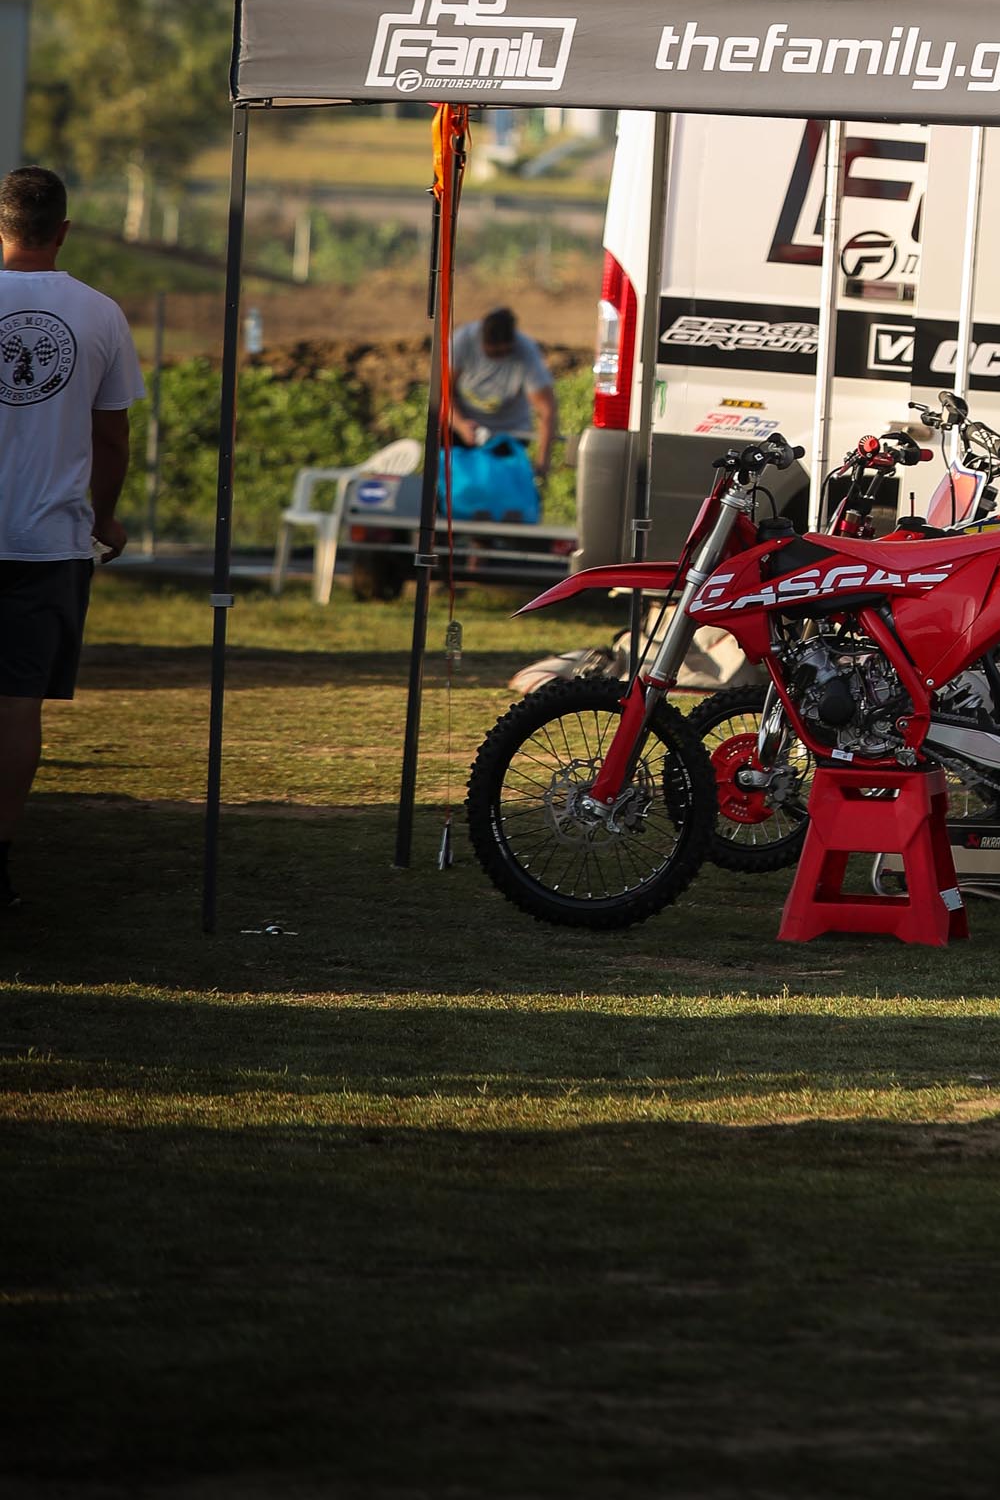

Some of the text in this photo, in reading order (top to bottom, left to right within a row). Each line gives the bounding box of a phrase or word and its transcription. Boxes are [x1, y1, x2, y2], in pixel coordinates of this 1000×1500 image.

[383, 18, 578, 91] Family
[421, 78, 502, 90] MOTORSPORT
[670, 316, 772, 334] PRO
